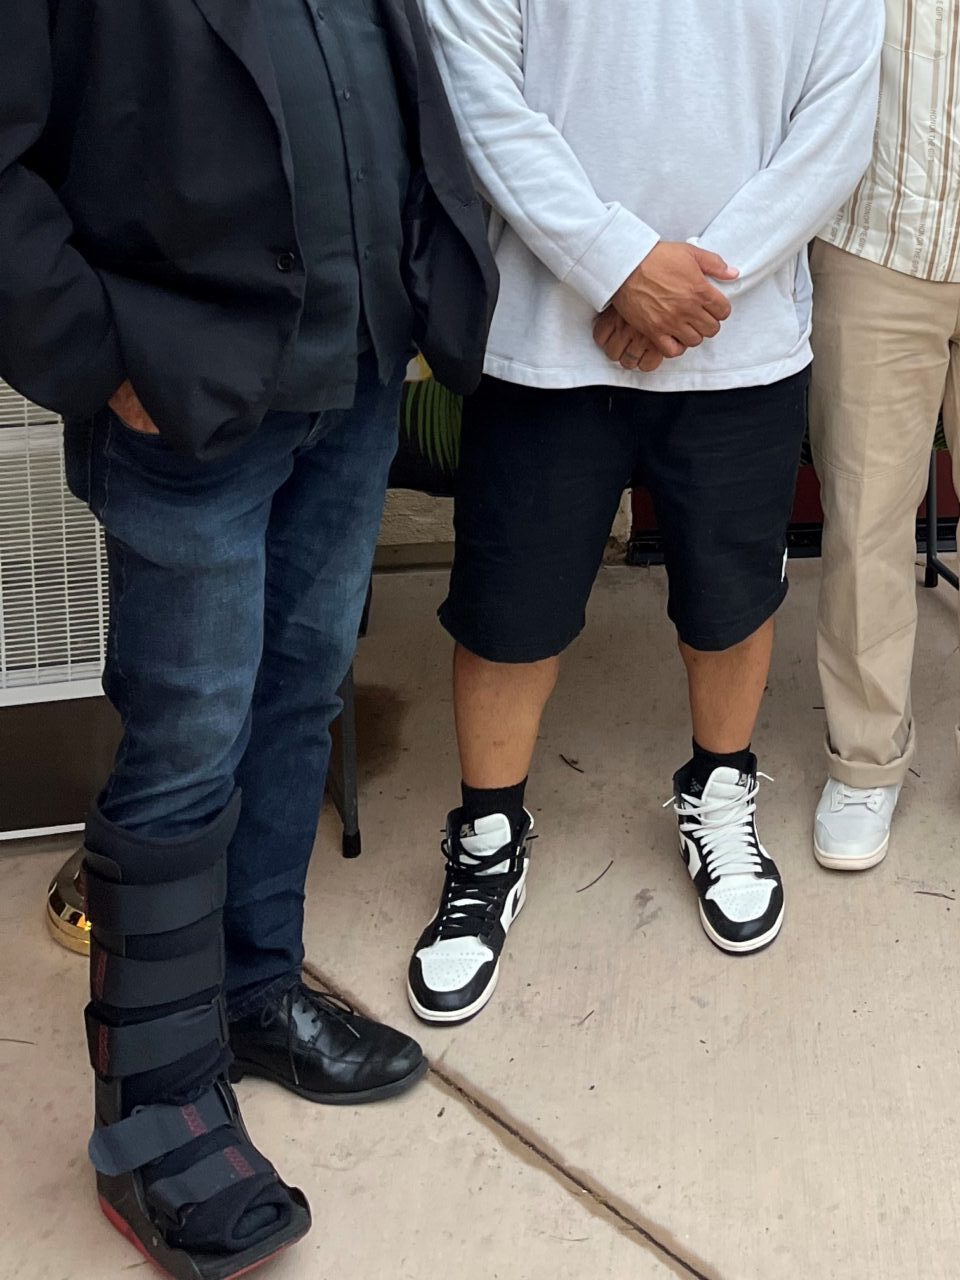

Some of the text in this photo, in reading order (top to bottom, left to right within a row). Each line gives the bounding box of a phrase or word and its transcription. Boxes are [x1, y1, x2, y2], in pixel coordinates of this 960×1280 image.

[936, 7, 944, 22] GIFT
[929, 110, 937, 133] HONOR
[863, 201, 873, 224] HONOR
[917, 223, 926, 246] HONOR
[913, 248, 922, 259] THE
